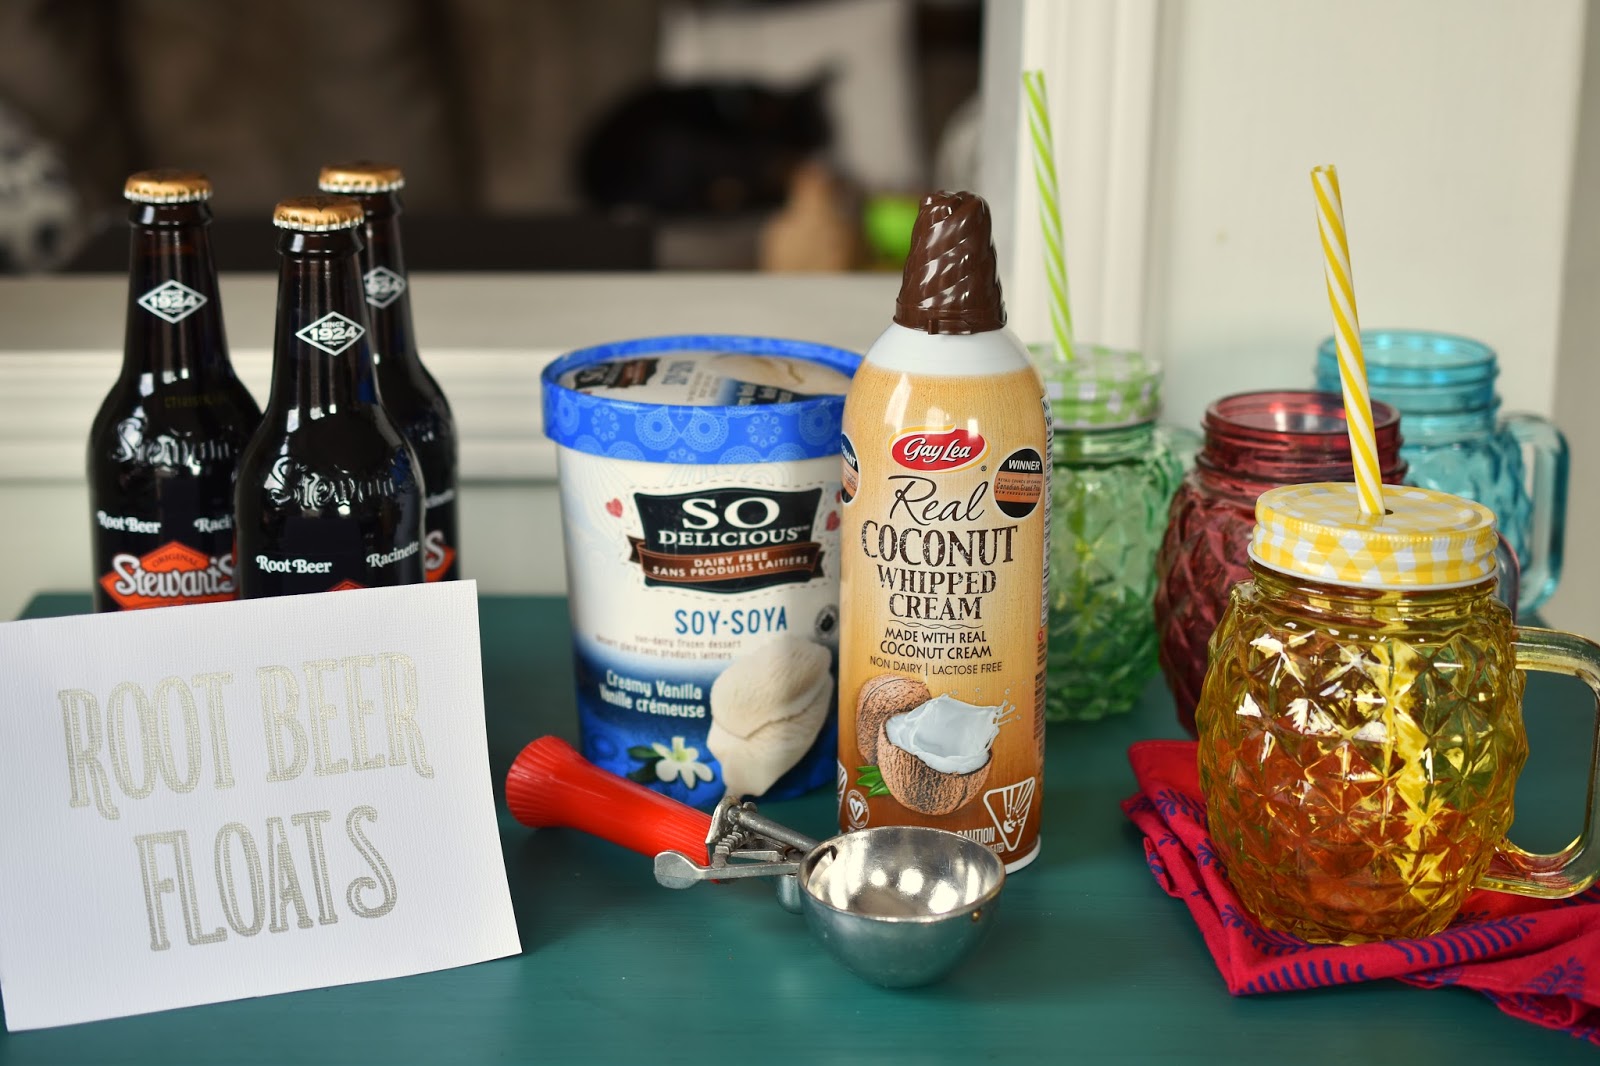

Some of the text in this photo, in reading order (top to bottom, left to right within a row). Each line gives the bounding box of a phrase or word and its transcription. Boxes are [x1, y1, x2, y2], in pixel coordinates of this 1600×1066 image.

[150, 295, 198, 309] 1924
[310, 326, 357, 341] 1924
[903, 437, 972, 464] Gay Lea
[1008, 460, 1041, 471] WINNER
[888, 475, 989, 526] Real
[97, 510, 162, 534] Root Beer
[682, 497, 780, 530] SO
[658, 529, 799, 547] DELICIOUS
[861, 520, 1018, 567] COCONUT
[256, 555, 333, 574] Root Beer
[652, 555, 809, 577] SANS PRODUITS LAITIERS
[694, 551, 769, 568] DAIRY FREE
[877, 564, 997, 595] WHIPPED
[889, 593, 983, 620] CREAM
[885, 627, 987, 643] MADE WITH REAL
[880, 640, 992, 659] COCONUT CREAM
[869, 656, 1003, 675] NON DAIRY LACTOSE FREE
[606, 669, 702, 700] Creamy Vanilla
[636, 698, 705, 718] crémeuse
[58, 651, 434, 820] ROOT BEER
[134, 805, 398, 952] FLOATS
